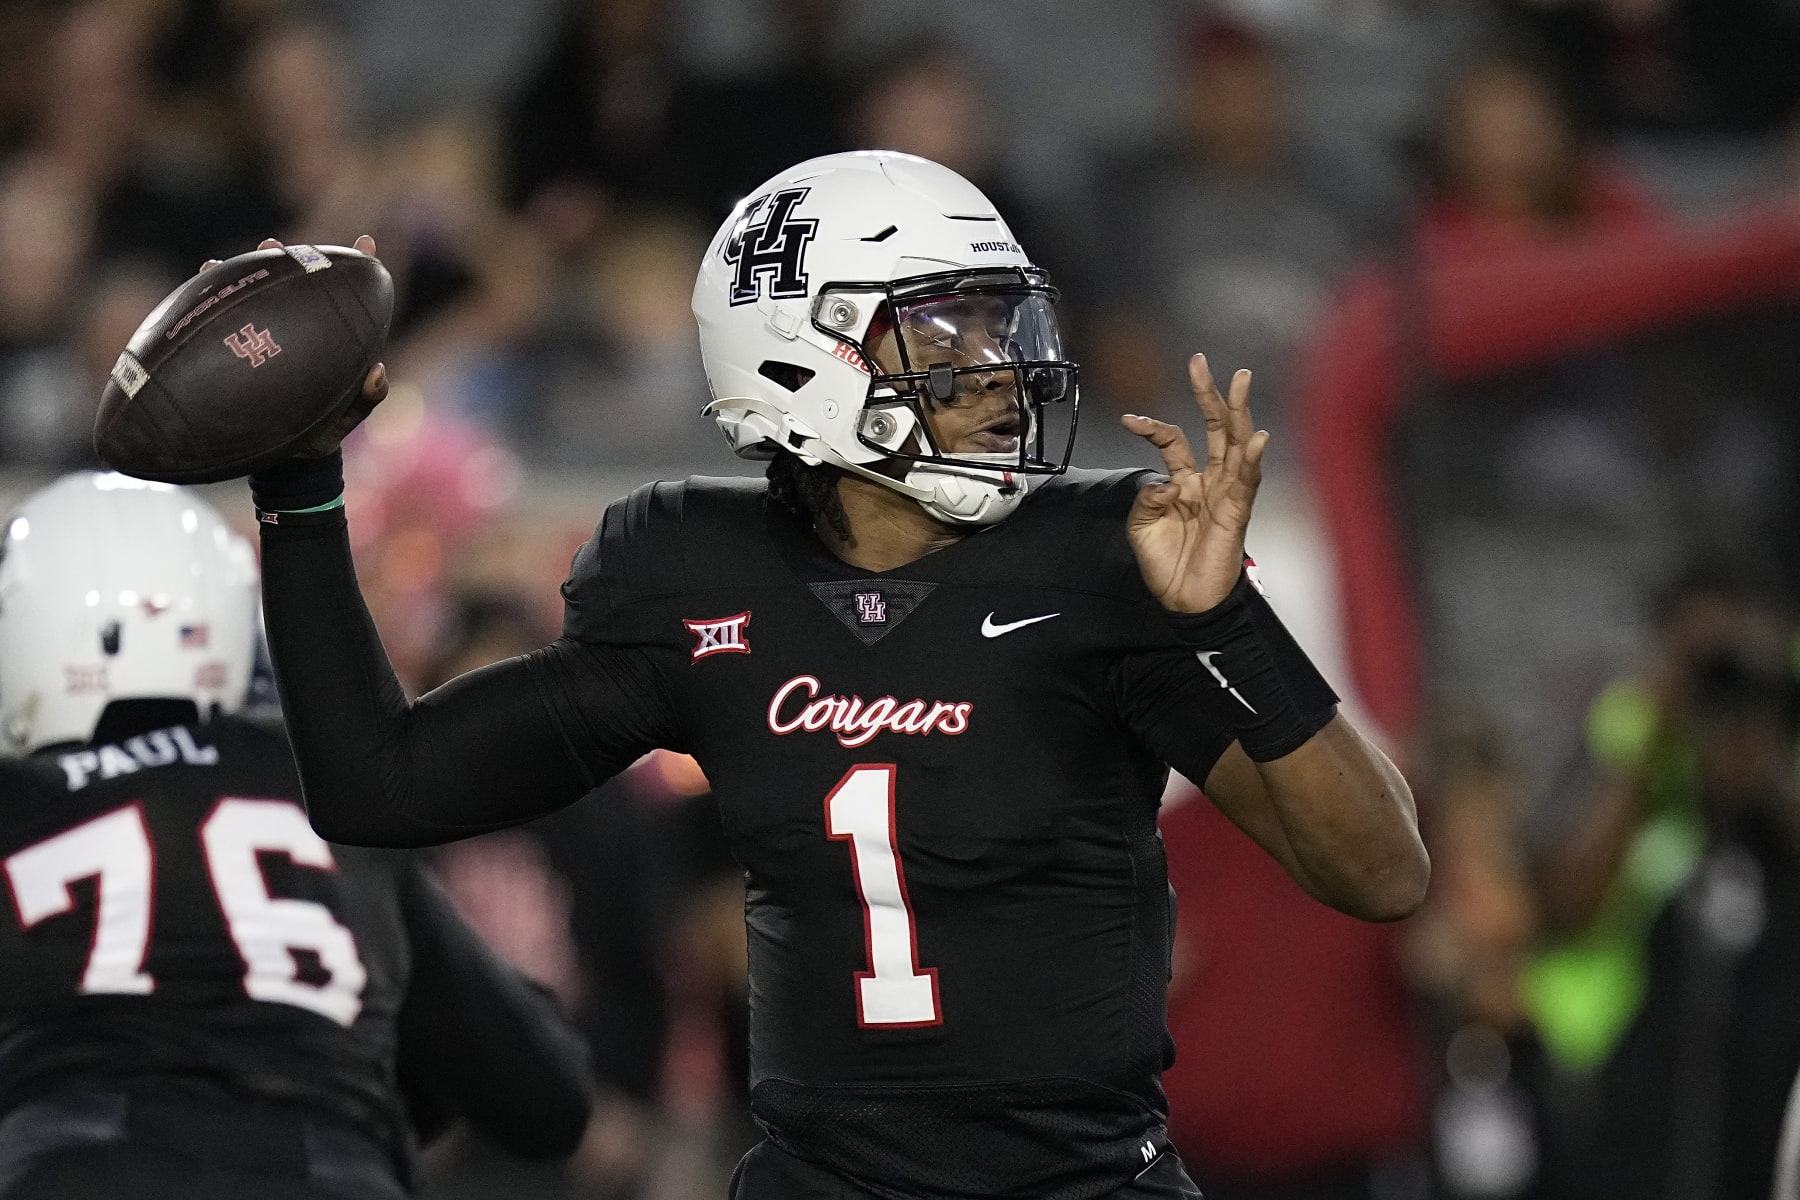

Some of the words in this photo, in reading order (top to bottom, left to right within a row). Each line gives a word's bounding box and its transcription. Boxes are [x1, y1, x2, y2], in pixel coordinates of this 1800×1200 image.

[723, 186, 820, 307] UH
[223, 322, 282, 369] UH
[687, 614, 748, 660] XII
[855, 593, 886, 622] UH
[767, 674, 973, 748] Cougars
[57, 725, 219, 792] PAUL
[3, 798, 367, 1028] 76
[823, 763, 944, 1030] 1
